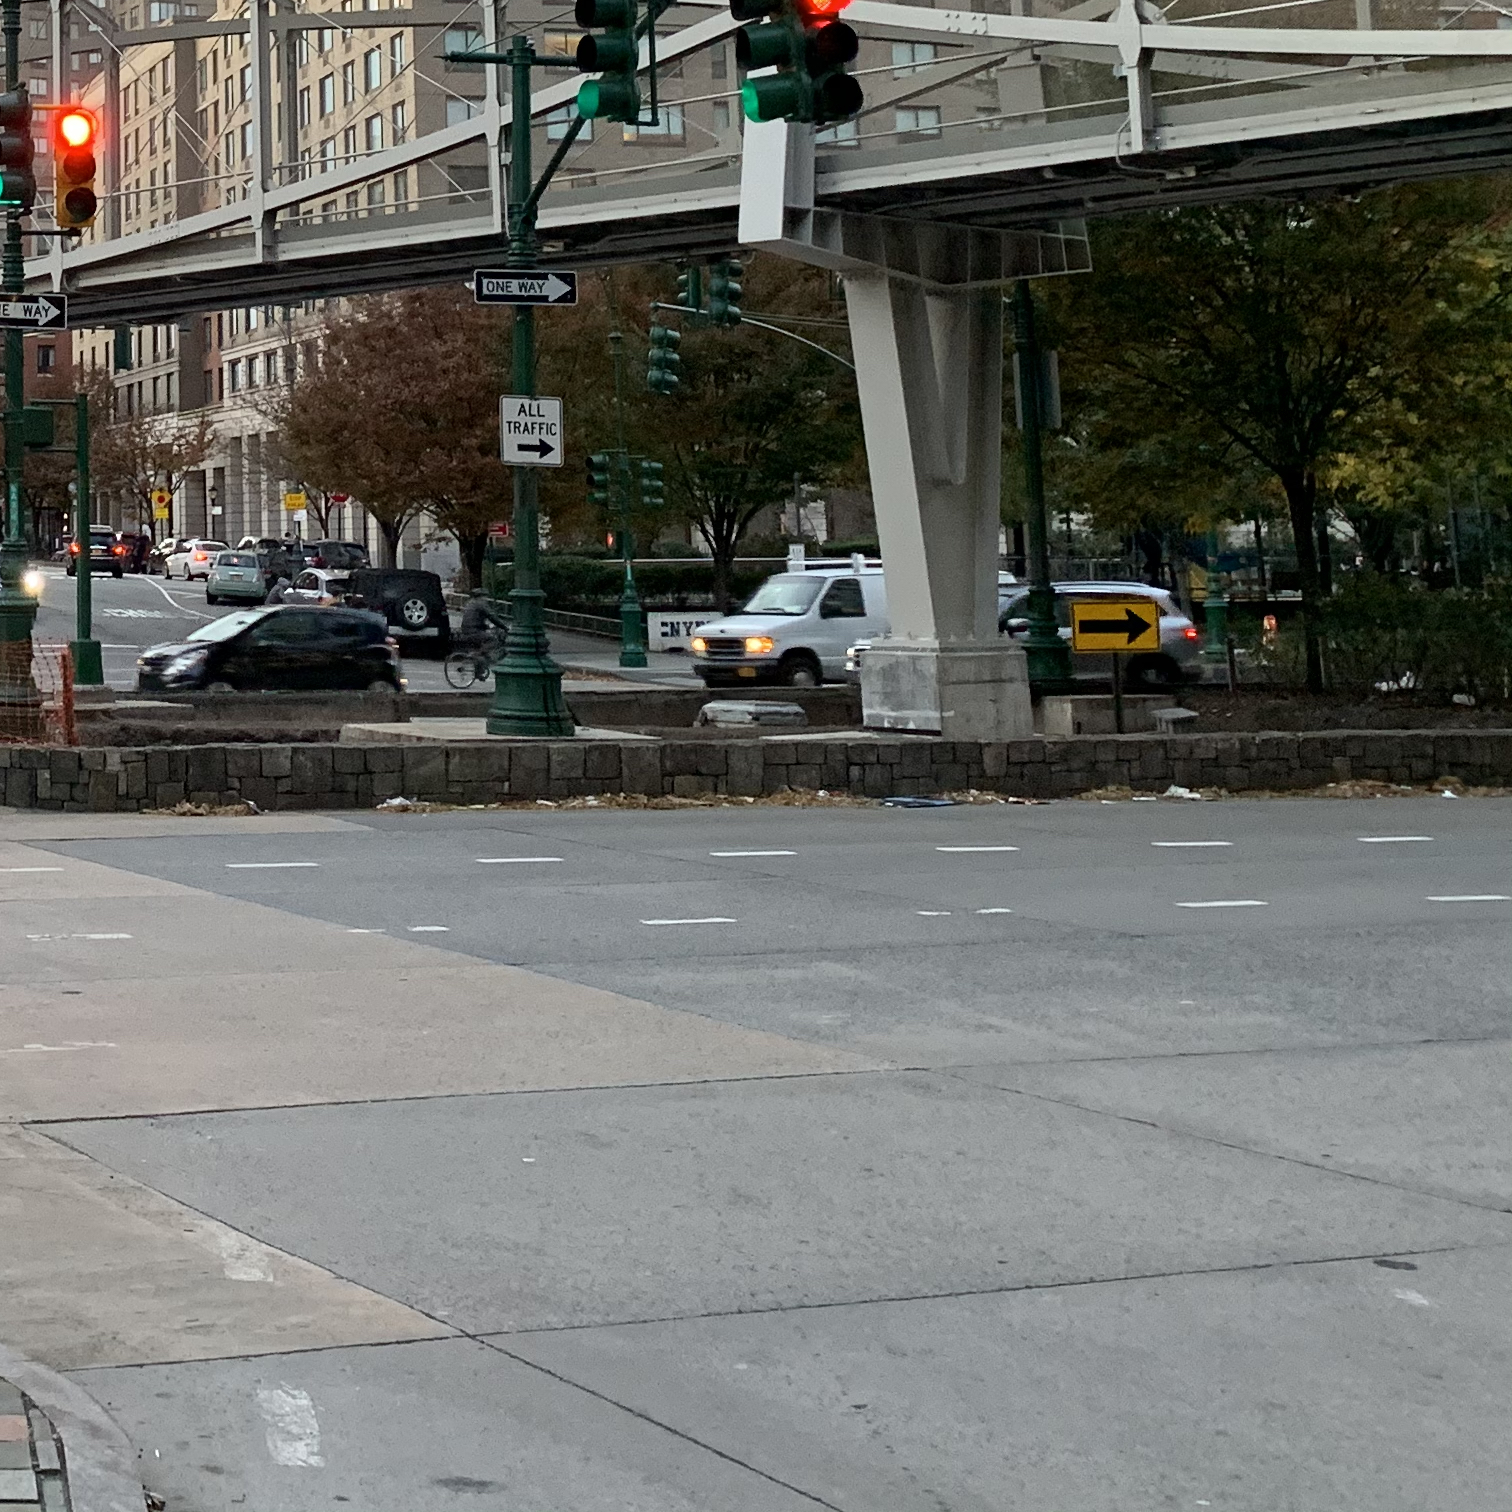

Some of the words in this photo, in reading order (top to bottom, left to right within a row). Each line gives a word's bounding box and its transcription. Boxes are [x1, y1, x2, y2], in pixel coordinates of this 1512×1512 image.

[487, 280, 512, 293] ONE
[518, 281, 545, 293] WAY
[23, 305, 51, 318] WAY
[517, 402, 545, 417] ALL
[506, 420, 557, 436] TRAFFIC
